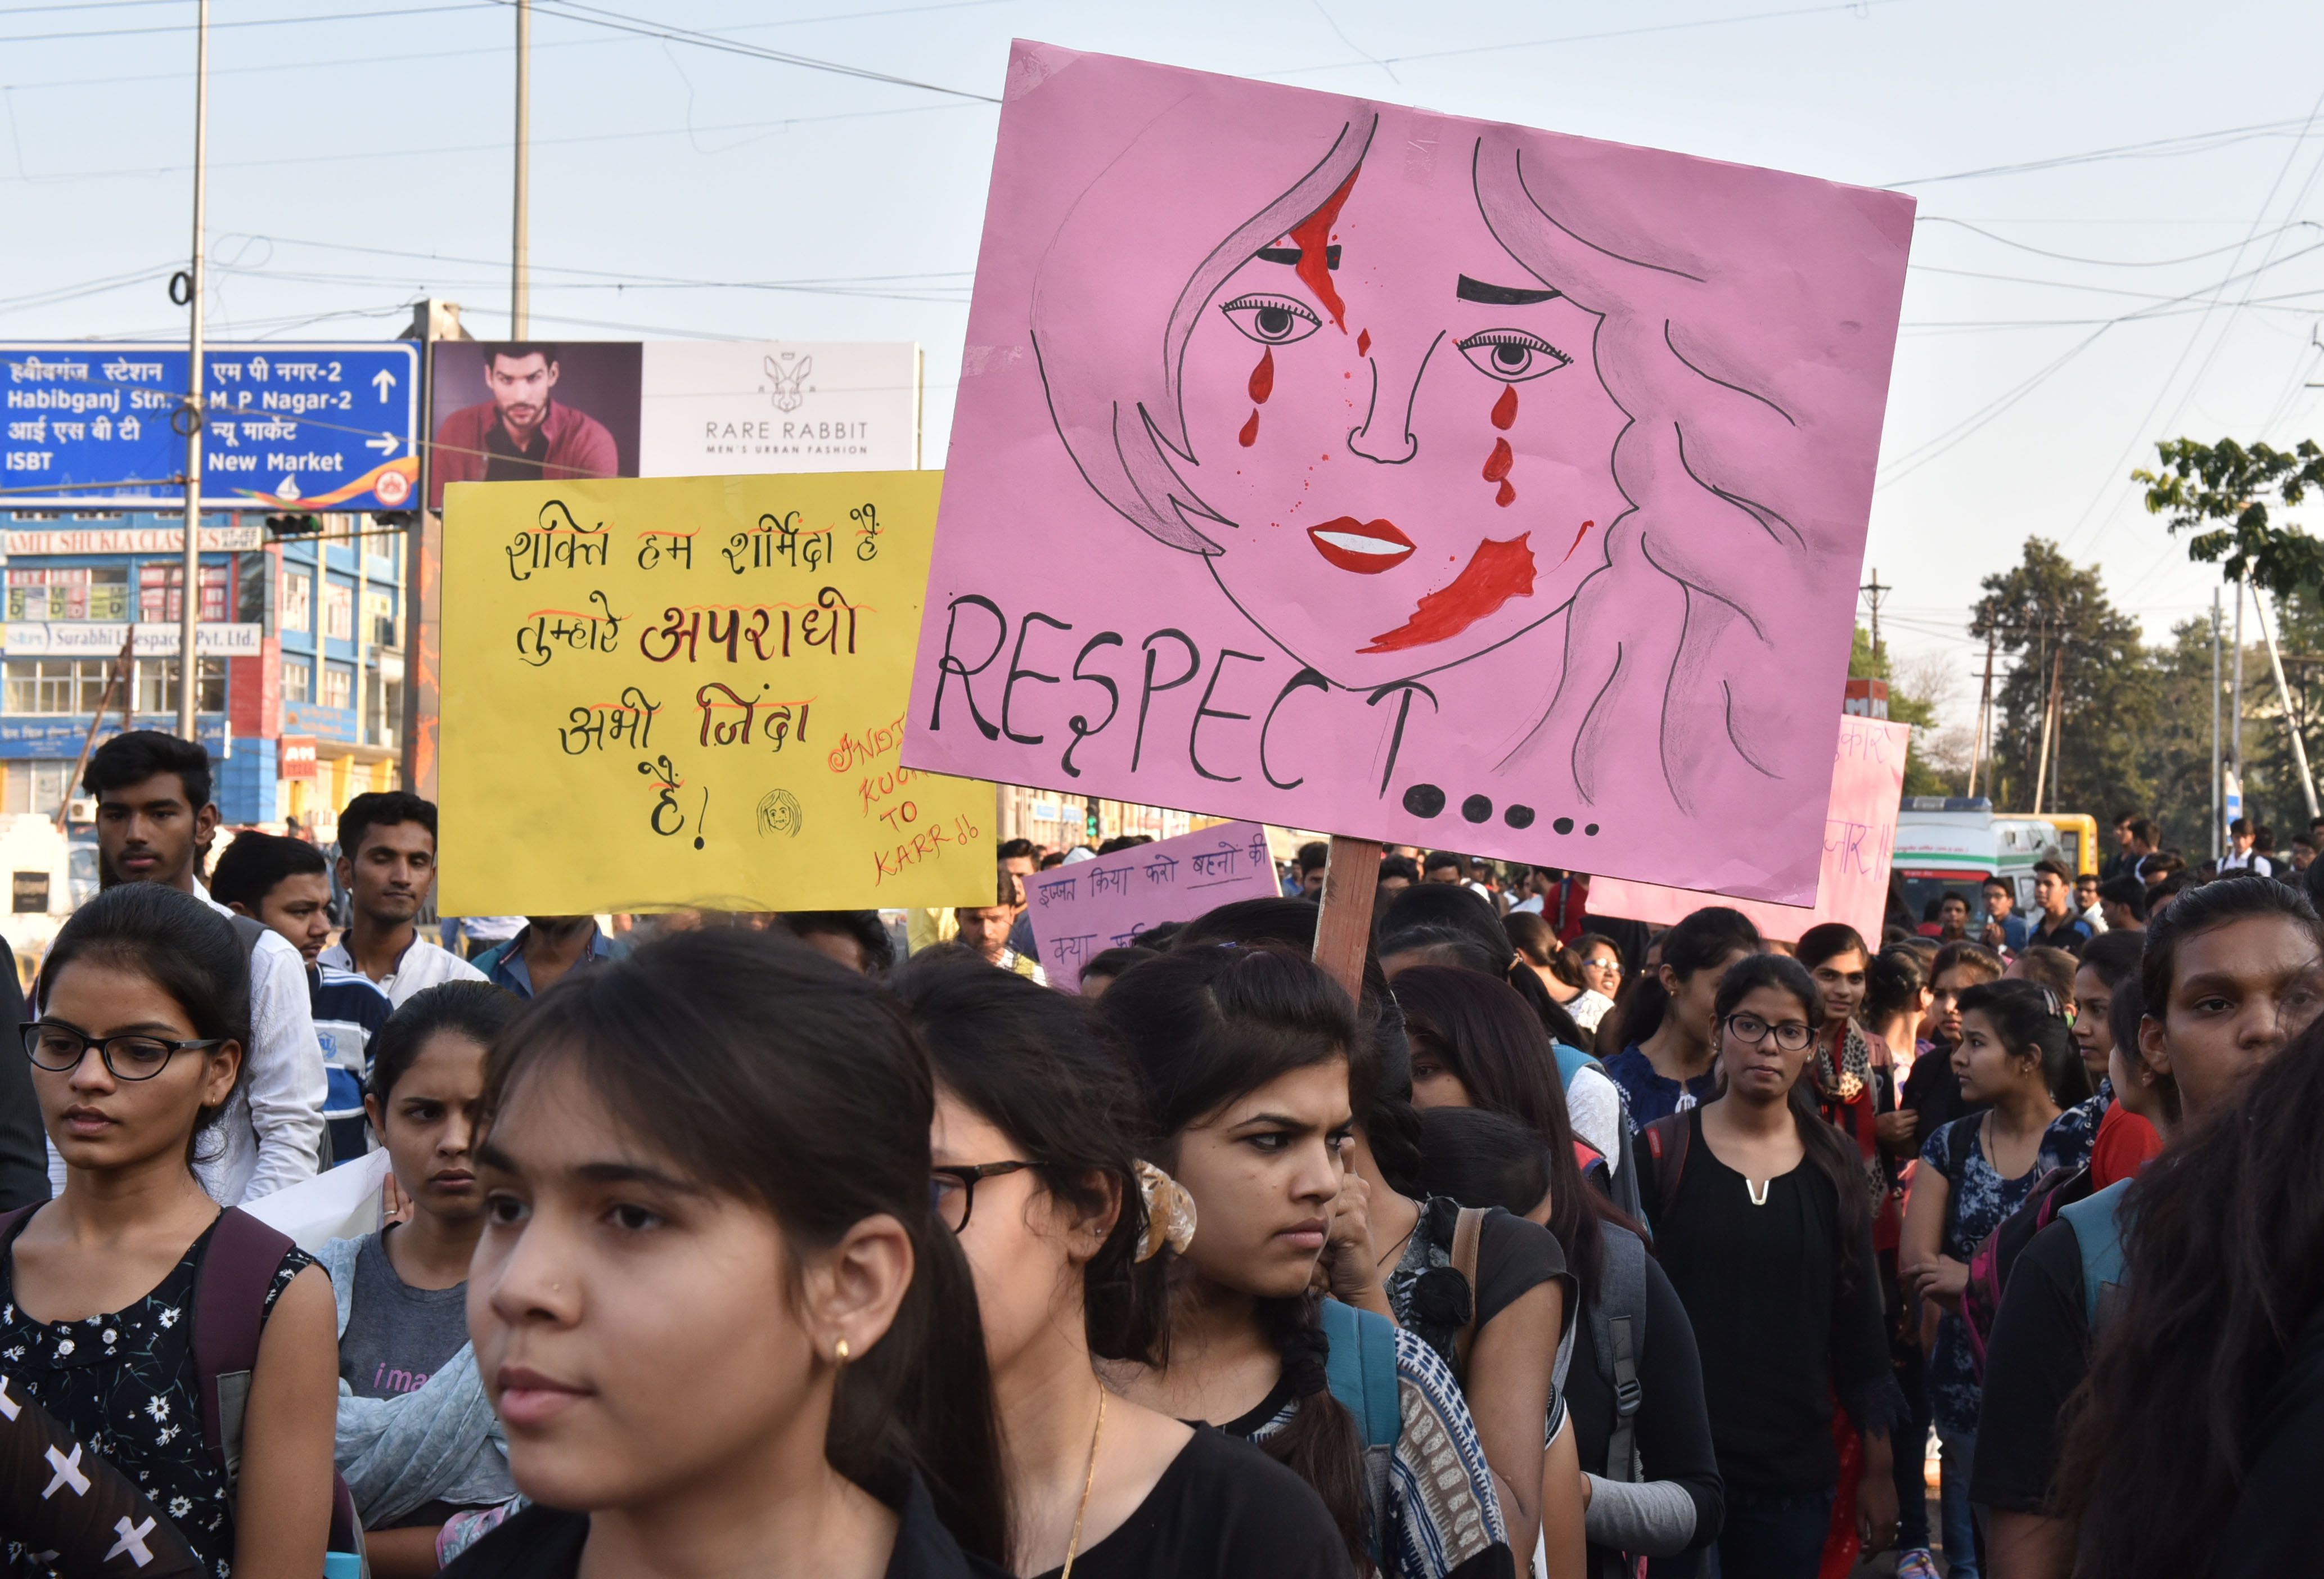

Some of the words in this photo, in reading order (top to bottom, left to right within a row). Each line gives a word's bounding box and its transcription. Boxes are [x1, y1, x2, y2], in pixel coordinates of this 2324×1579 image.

[101, 357, 164, 382] स्टेशन
[211, 362, 242, 385] एम
[247, 356, 270, 382] पी
[274, 362, 343, 382] नगर-2
[8, 389, 120, 414] Habibganj
[130, 390, 172, 409] Stn.
[210, 391, 227, 409] M
[238, 391, 253, 410] P
[262, 390, 353, 414] Nagar-2
[8, 414, 47, 444] आई
[52, 422, 86, 444] एस
[117, 414, 141, 441] टी
[210, 421, 240, 448] न्यू
[705, 422, 770, 439] RARE
[782, 422, 868, 439] RABBIT
[6, 451, 54, 471] ISBT
[209, 452, 258, 472] New
[267, 452, 344, 472] Market
[705, 445, 747, 454] MEN'S
[755, 445, 799, 454] URBAN
[808, 445, 868, 454] FASHION
[7, 533, 55, 553] AMIT
[60, 531, 134, 552] SHUKLA
[139, 530, 219, 551] CLASES
[637, 526, 701, 570] हम
[57, 629, 112, 646] Surabhi
[196, 630, 223, 647] Pvt.
[228, 630, 255, 647] Ltd.
[517, 590, 634, 667] तुम्हारे
[639, 587, 878, 663] अपराधी
[558, 687, 664, 755] अभी
[880, 801, 917, 832] TO
[1087, 867, 1134, 897] किया
[1143, 854, 1179, 885] करो
[1249, 833, 1268, 867] की
[385, 1369, 434, 1393] ma
